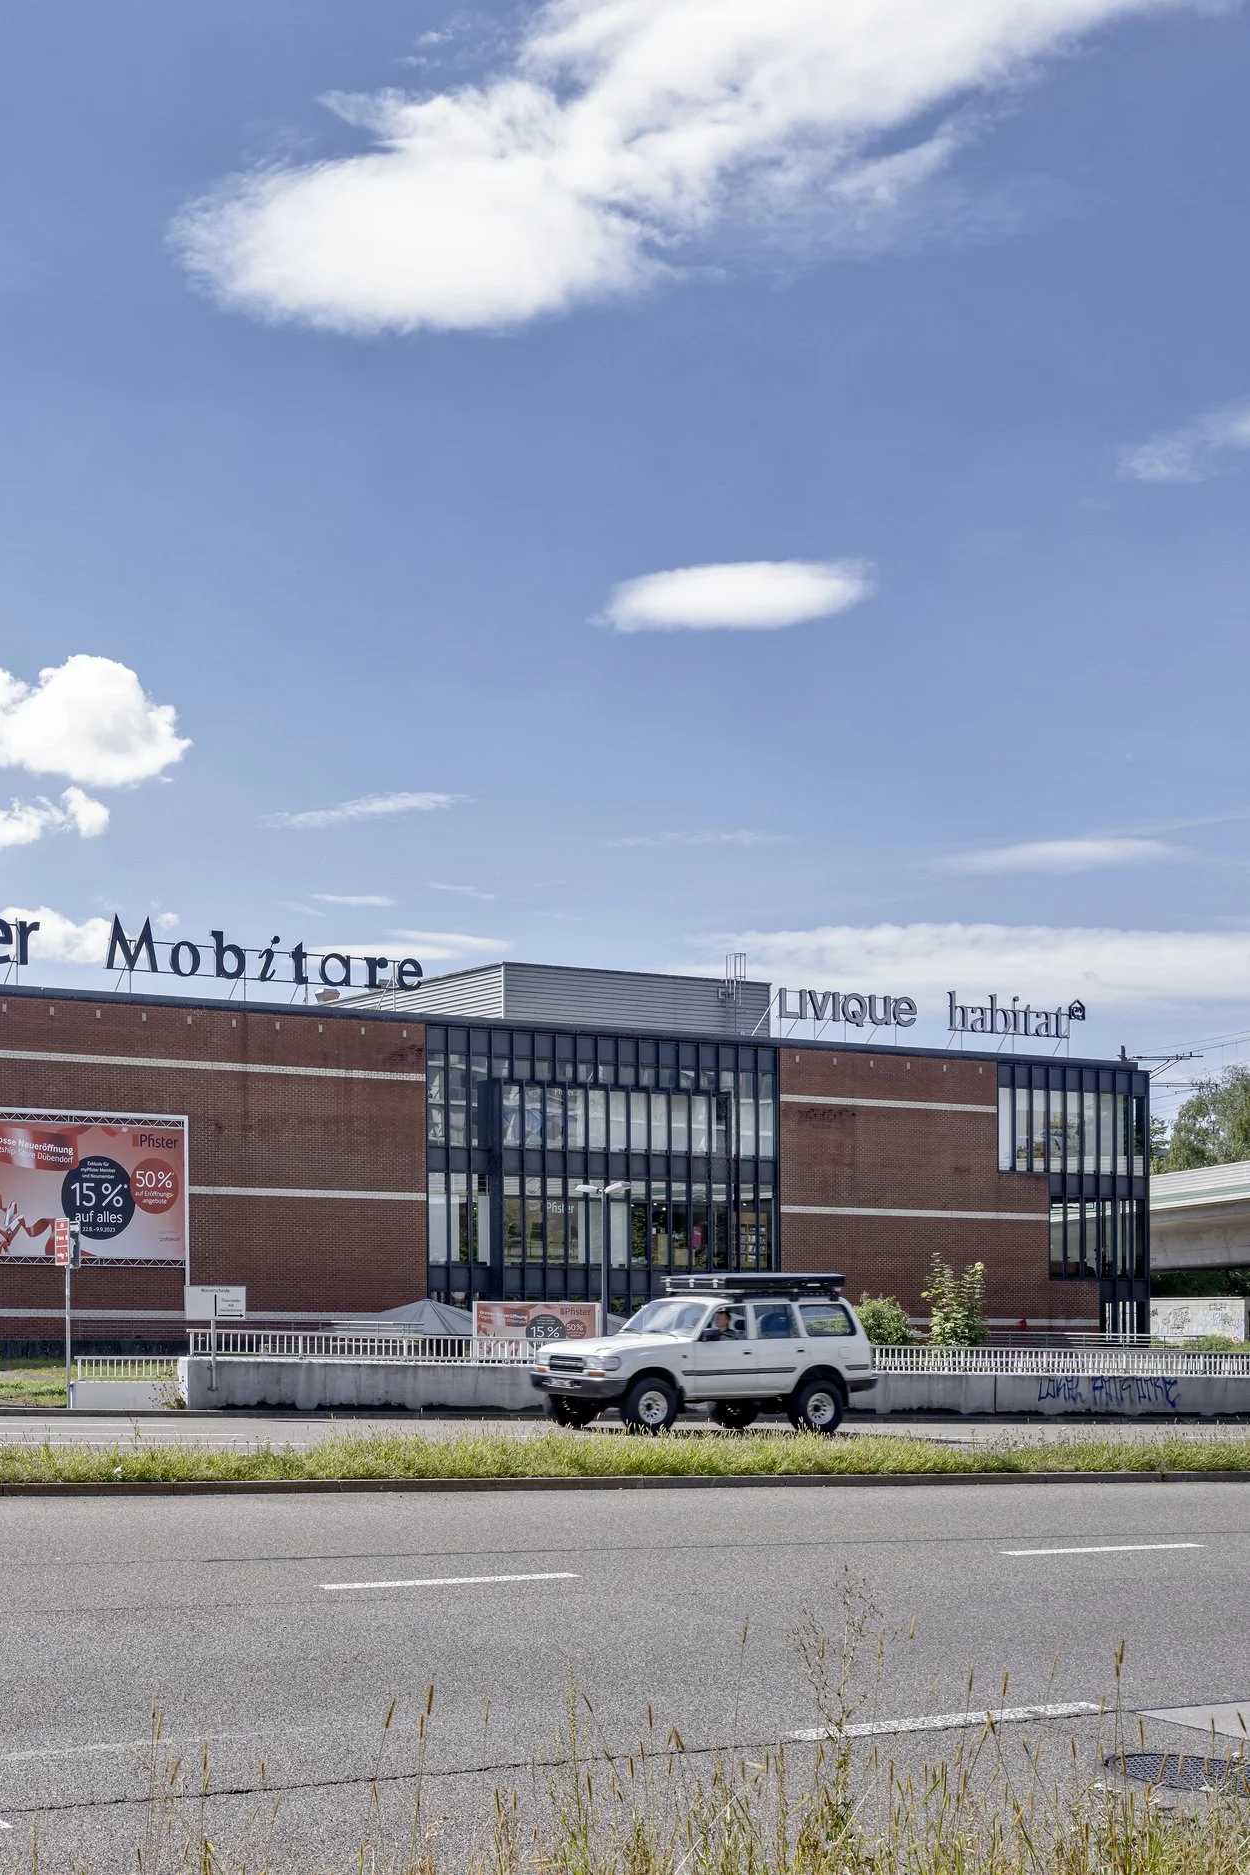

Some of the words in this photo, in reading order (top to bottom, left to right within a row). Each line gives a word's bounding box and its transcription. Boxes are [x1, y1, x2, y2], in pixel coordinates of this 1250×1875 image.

[105, 912, 424, 991] Mobitare
[946, 990, 1071, 1039] habitat
[18, 1139, 74, 1155] Neueröffnung
[139, 1133, 179, 1149] Pfister
[37, 1151, 73, 1164] Dübendorf
[74, 1210, 95, 1223] auf
[96, 1210, 123, 1223] alles
[565, 1306, 591, 1316] Pfister
